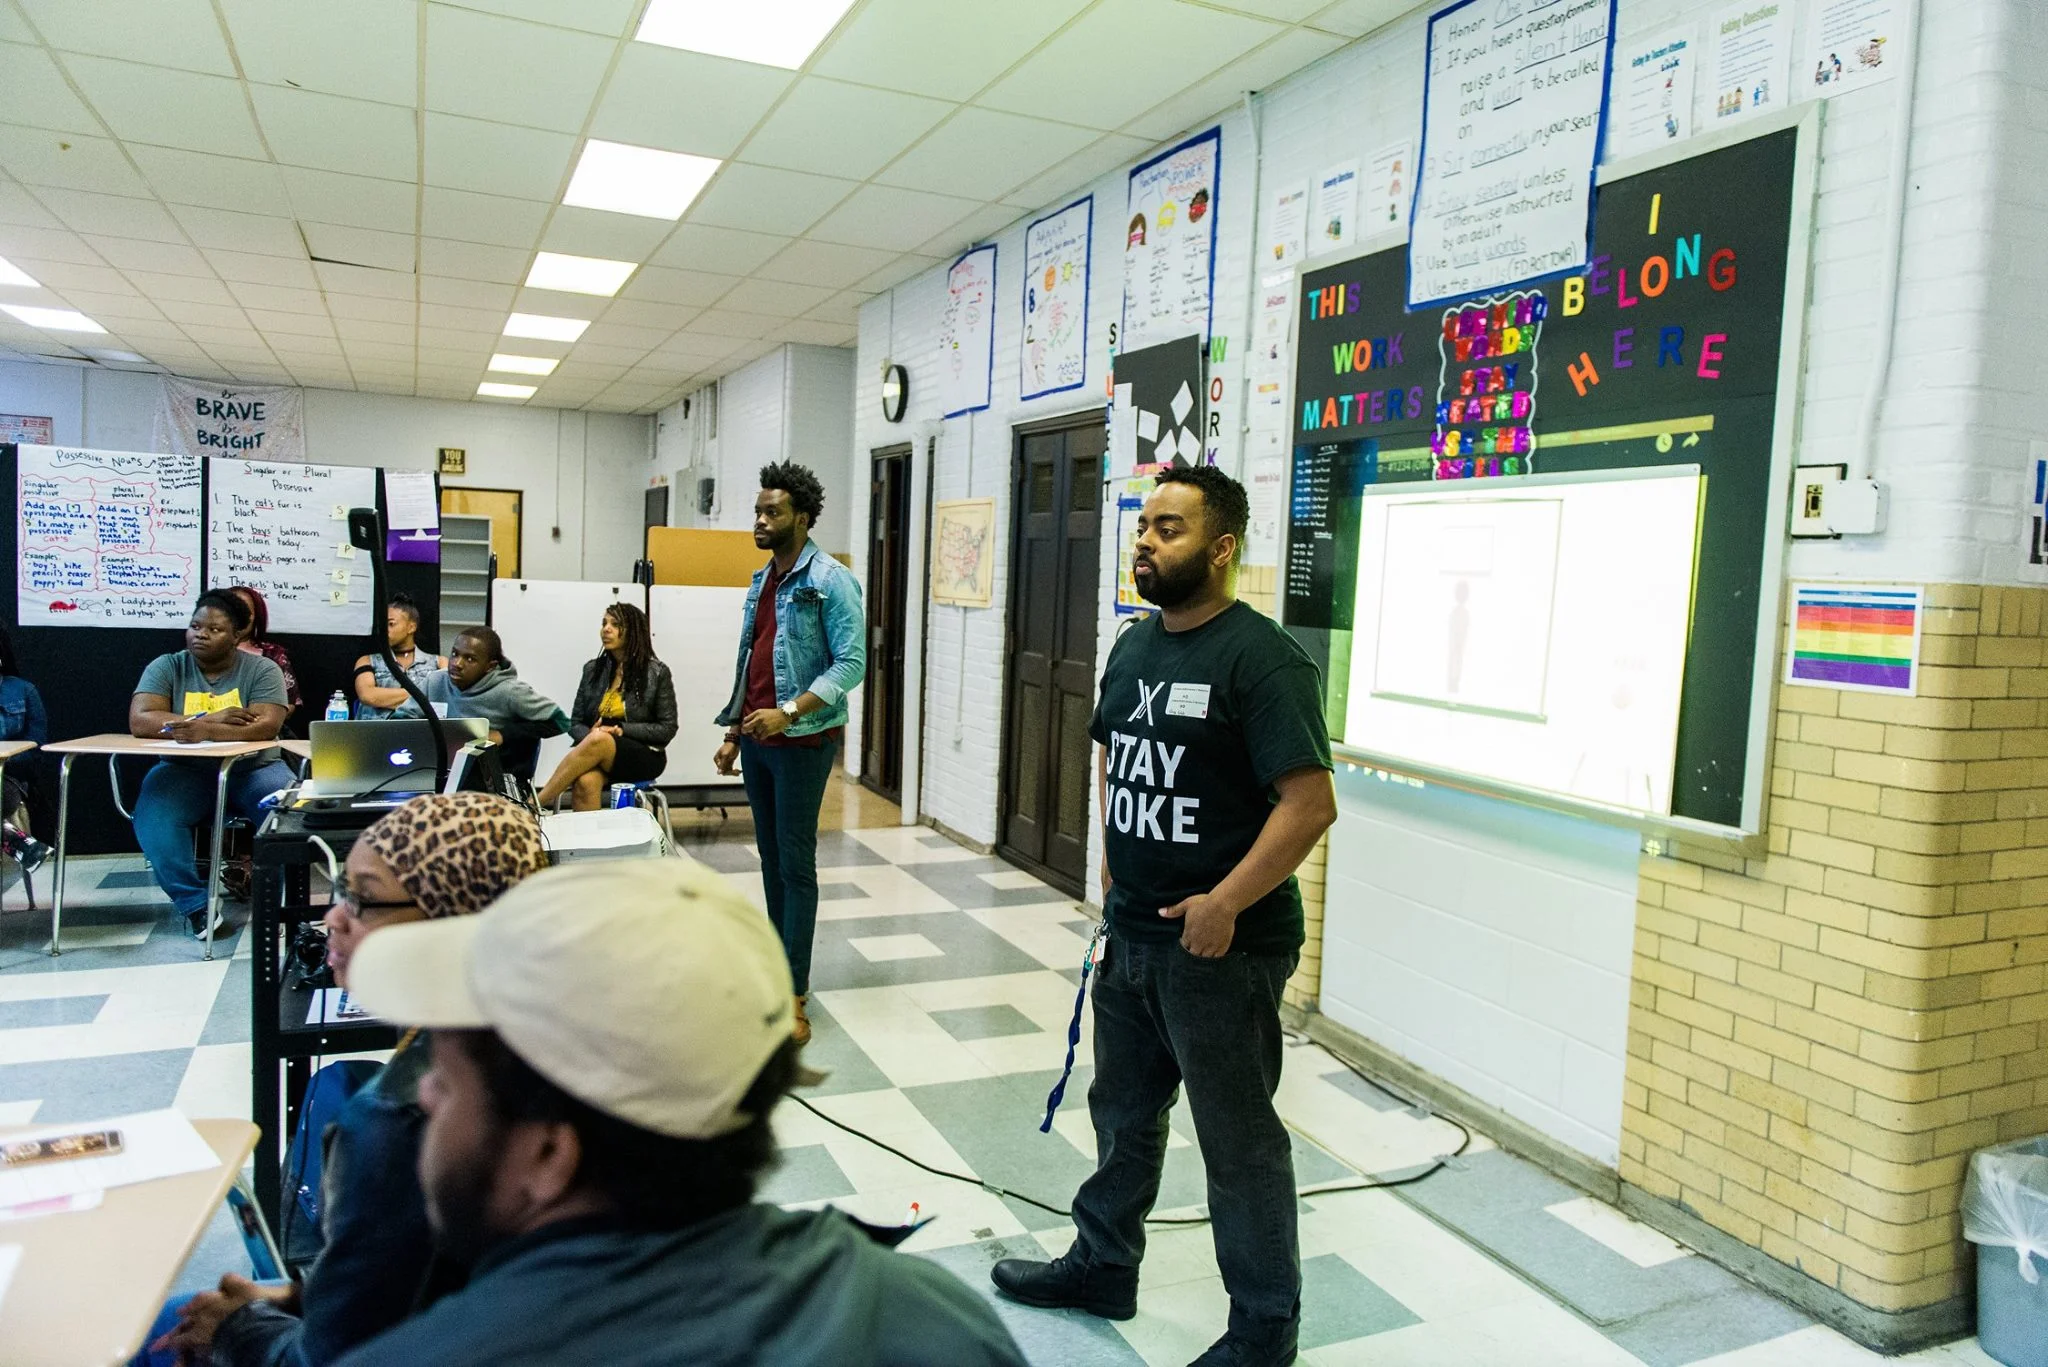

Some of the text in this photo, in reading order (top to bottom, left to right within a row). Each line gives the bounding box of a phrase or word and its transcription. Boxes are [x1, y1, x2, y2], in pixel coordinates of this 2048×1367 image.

[1448, 18, 1486, 42] Honor
[1460, 72, 1493, 96] raise
[1497, 66, 1507, 80] a
[1572, 16, 1606, 49] Hand
[1464, 44, 1488, 65] you
[1491, 33, 1514, 49] have
[1515, 27, 1523, 40] a
[1459, 91, 1486, 117] and
[1531, 72, 1544, 90] to
[1547, 68, 1560, 87] be
[1563, 53, 1600, 82] called
[1458, 123, 1473, 140] on
[1542, 118, 1570, 147] your
[1570, 108, 1601, 132] seat
[1523, 166, 1567, 190] unless
[1504, 182, 1575, 216] instructed
[1648, 193, 1661, 235] I
[1470, 223, 1502, 243] adult
[1426, 254, 1448, 271] Use
[1562, 233, 1738, 317] BELONG
[1308, 282, 1362, 321] THIS
[1332, 332, 1404, 375] WORK
[1567, 326, 1728, 397] HERE
[1459, 362, 1519, 395] STAY
[196, 397, 266, 421] BRAVE
[1207, 336, 1228, 467] WORK
[1302, 386, 1424, 431] MATTERS
[1435, 391, 1531, 424] SEATED
[197, 429, 266, 449] BRIGHT
[56, 448, 143, 468] Possessive Nouns
[444, 449, 462, 459] YOU
[244, 462, 277, 477] Singular
[304, 466, 332, 478] Plural
[271, 478, 313, 493] Possessive
[24, 501, 45, 510] Add
[231, 494, 249, 506] The
[277, 499, 290, 509] fur
[23, 510, 67, 519] apostrophe
[50, 521, 75, 529] make
[226, 521, 244, 535] The
[279, 526, 320, 538] bathroom
[227, 537, 245, 545] was
[247, 536, 271, 546] clean
[344, 544, 351, 553] P
[64, 562, 82, 570] bike
[226, 550, 244, 561] The
[276, 556, 298, 565] pages
[273, 580, 289, 590] ball
[337, 570, 344, 580] S
[334, 591, 340, 600] P
[1106, 730, 1186, 789] STAY
